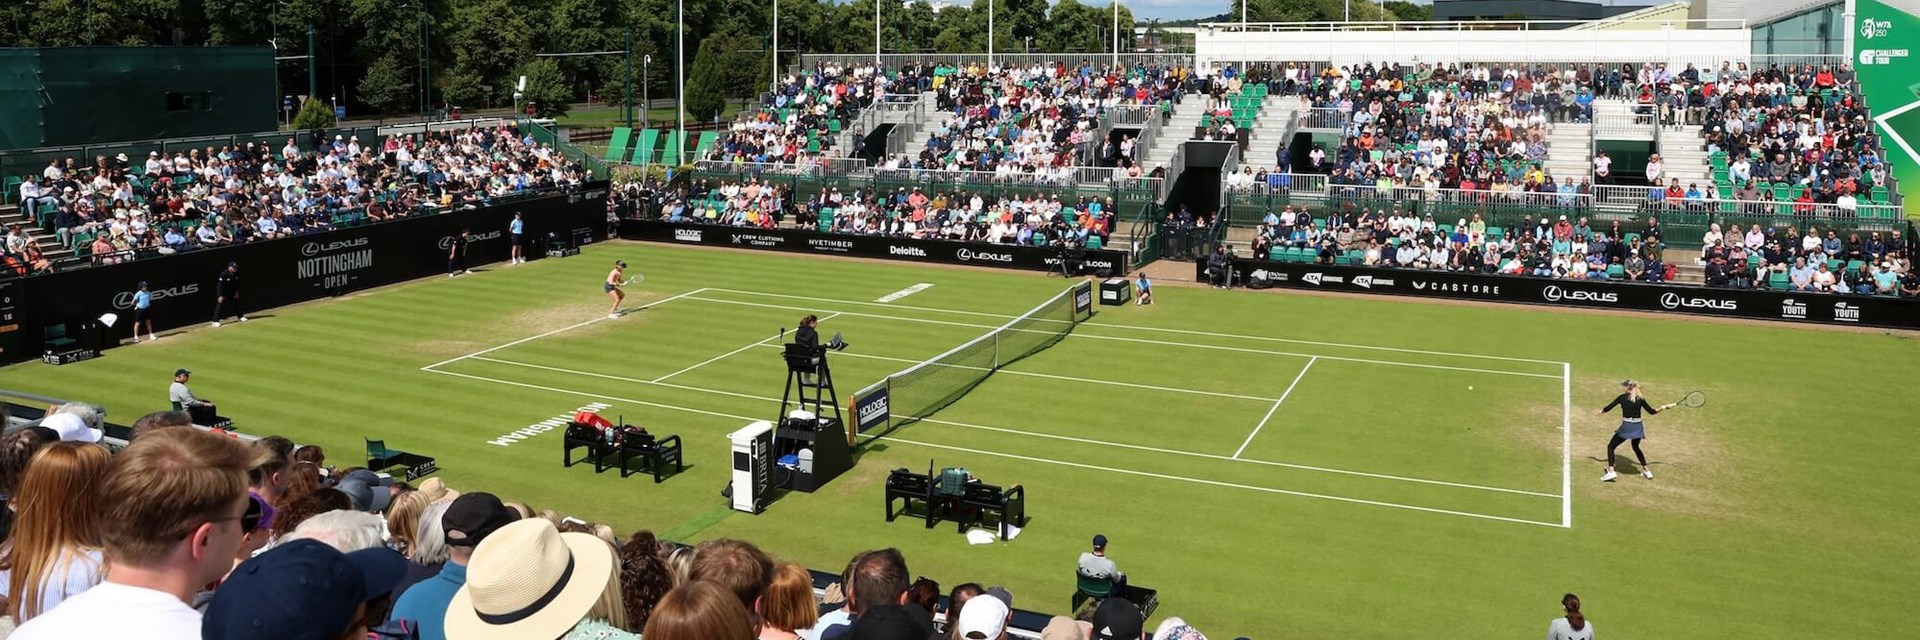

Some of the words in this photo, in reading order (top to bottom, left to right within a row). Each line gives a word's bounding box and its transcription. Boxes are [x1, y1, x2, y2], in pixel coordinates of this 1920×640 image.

[466, 230, 501, 243] EXUS
[321, 237, 369, 251] LEXUS
[808, 239, 853, 248] NYETIMBER
[890, 246, 927, 256] Deloitte.
[972, 251, 1013, 262] LEXUS
[298, 248, 373, 280] NOTTINGHAM
[324, 274, 348, 289] OPEN
[149, 283, 199, 301] EXUS
[1431, 282, 1500, 295] CASTORE
[1563, 289, 1618, 302] LEXUS
[1681, 297, 1737, 310] LEXUS
[1782, 305, 1806, 315] YOUTH
[1834, 308, 1860, 318] YOUTH
[860, 396, 888, 418] HOLOGIC
[759, 453, 768, 494] BRITA
